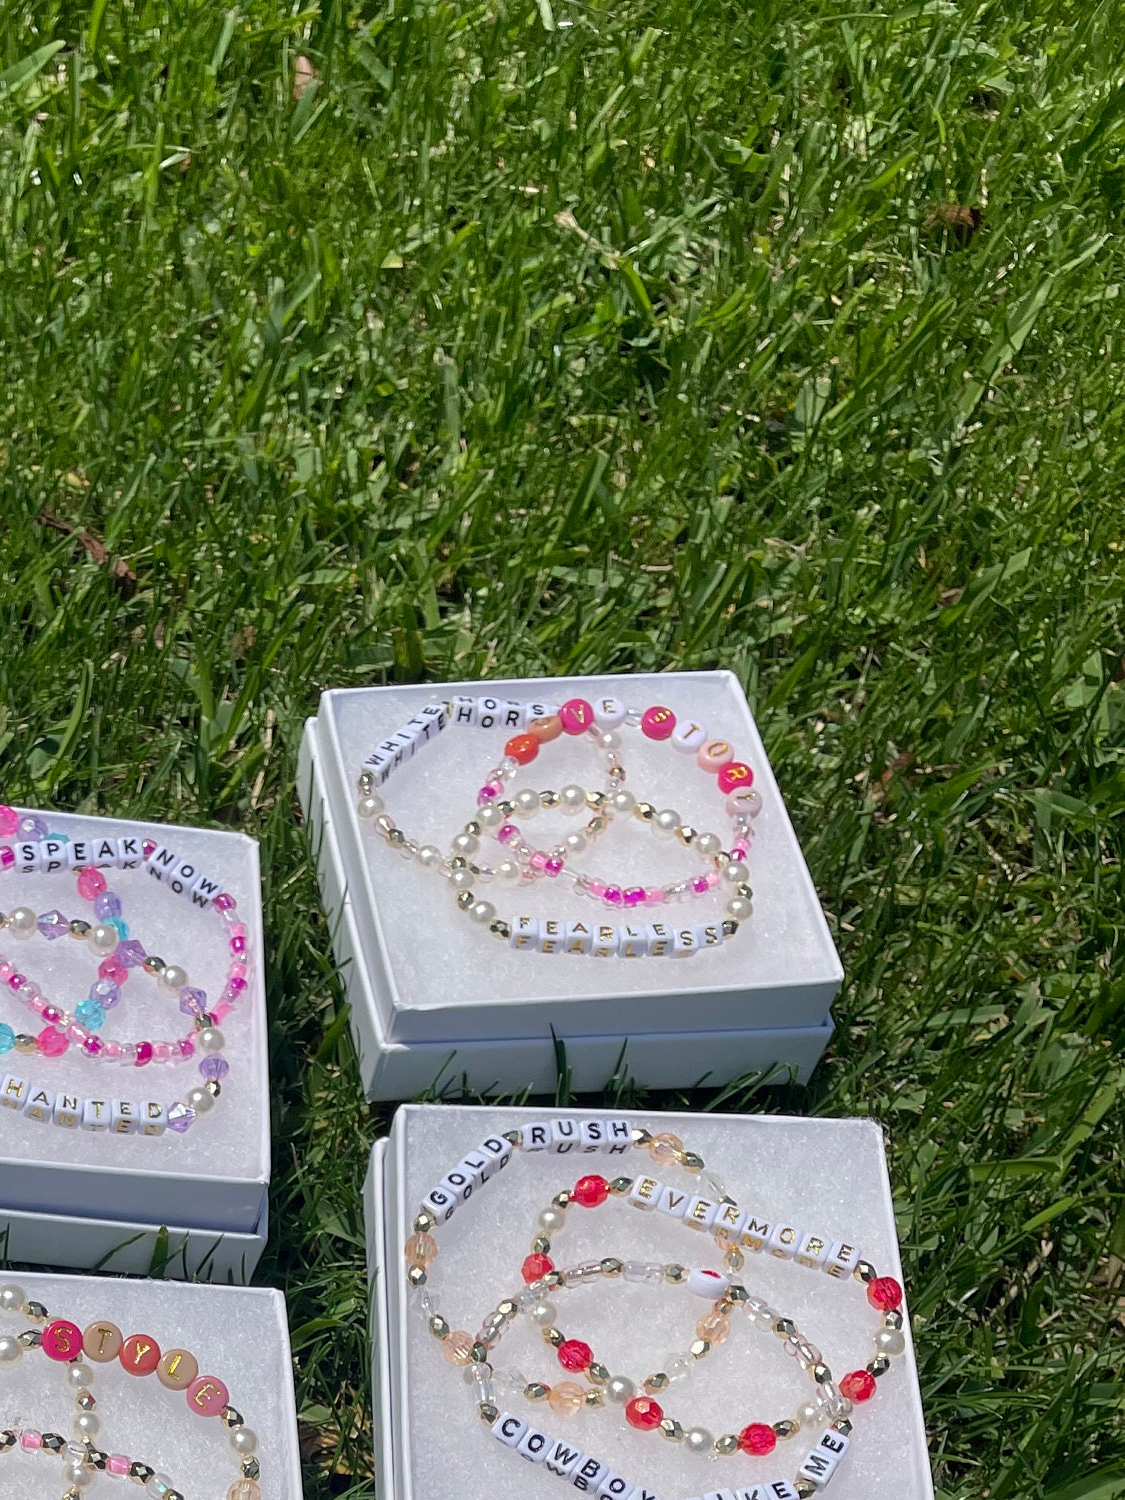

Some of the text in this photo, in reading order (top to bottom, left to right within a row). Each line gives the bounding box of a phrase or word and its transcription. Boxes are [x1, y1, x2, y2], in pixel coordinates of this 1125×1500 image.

[364, 695, 555, 781] WHITE HORS
[21, 837, 218, 908] SPEAK NOW
[515, 917, 719, 957] FEARLESS
[429, 1120, 630, 1206] GOLD RUSH
[635, 1179, 855, 1274] EVERMORE
[53, 1325, 221, 1410] STYLE
[805, 1434, 845, 1480] ME
